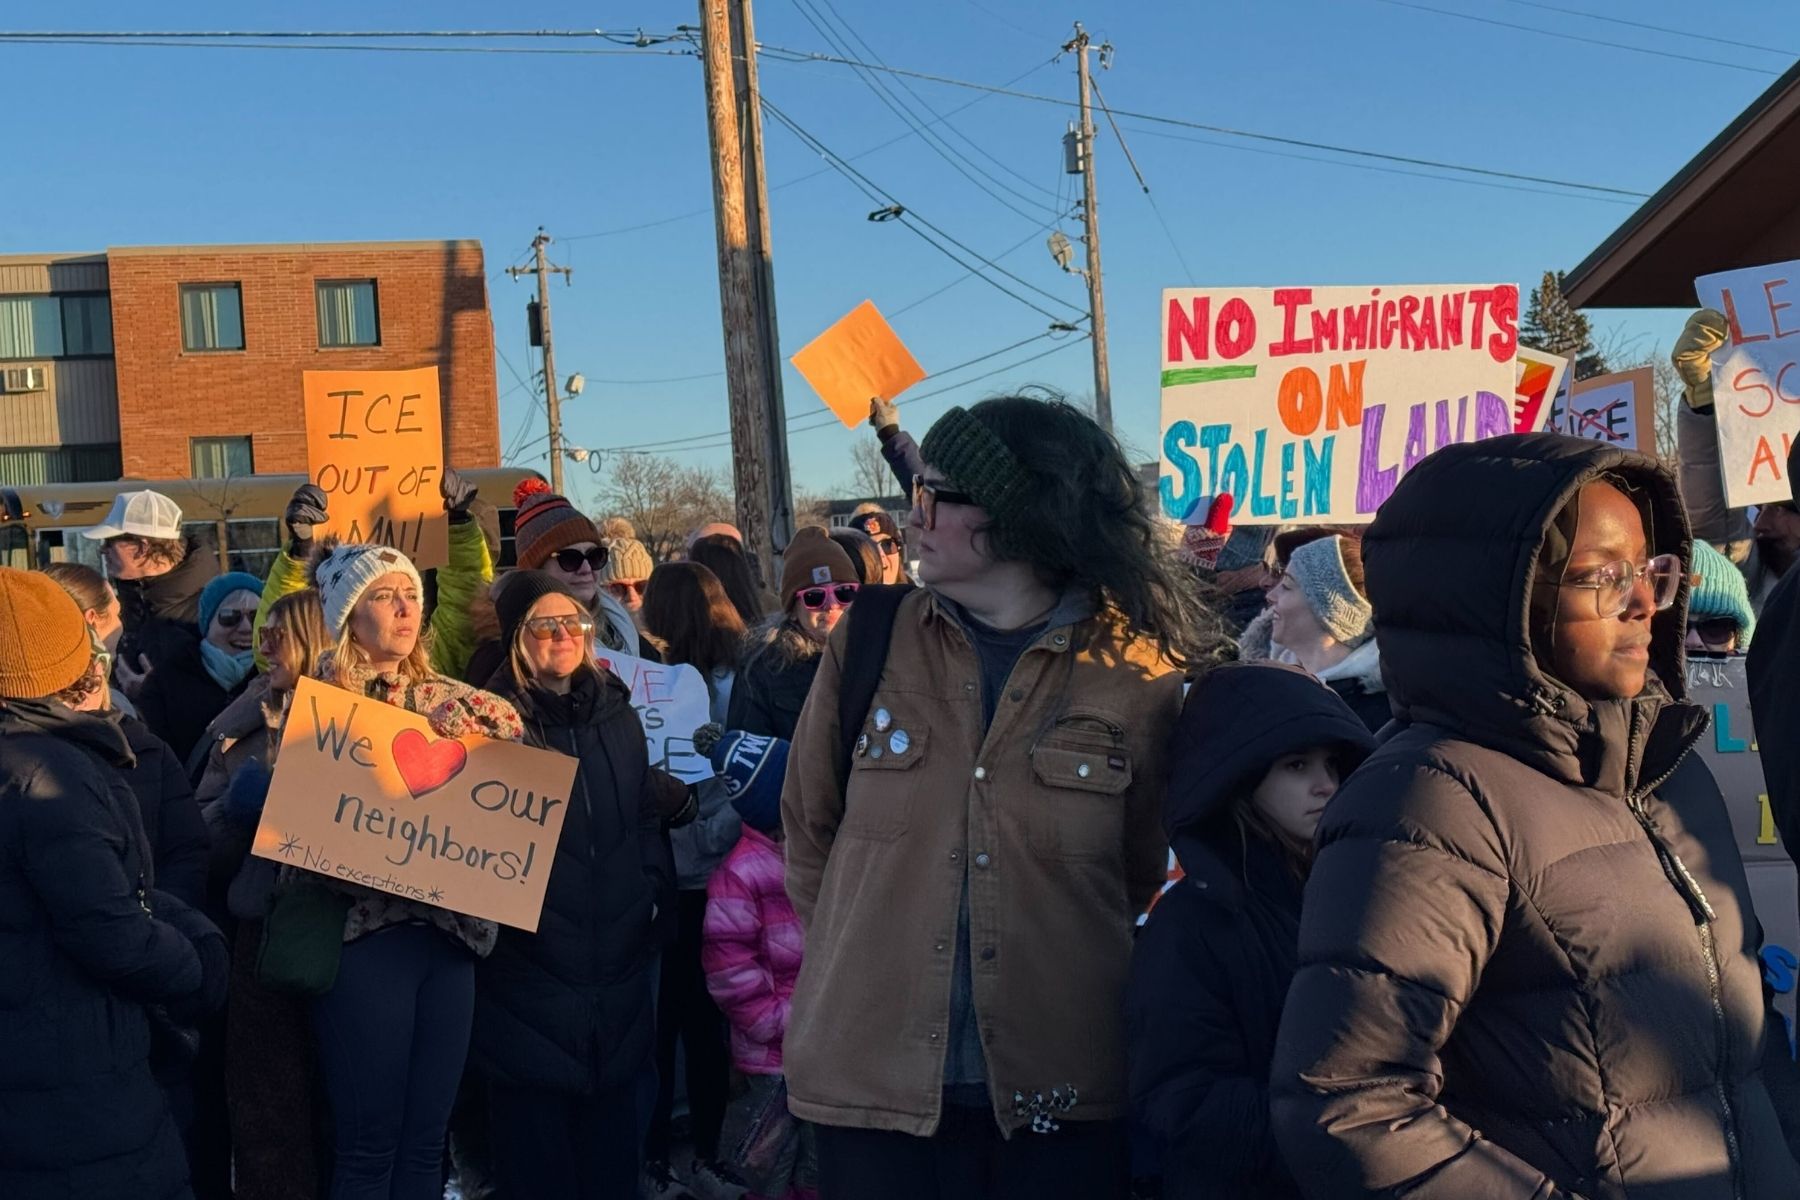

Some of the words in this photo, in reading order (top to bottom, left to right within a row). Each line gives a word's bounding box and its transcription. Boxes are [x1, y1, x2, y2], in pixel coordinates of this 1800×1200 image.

[1167, 296, 1257, 362] NO
[327, 390, 423, 439] ICE
[1277, 359, 1367, 436] ON
[316, 463, 390, 495] OUT
[397, 465, 437, 497] OF
[1159, 420, 1336, 520] STOLEN
[310, 695, 377, 768] We
[334, 792, 536, 885] neighbors!
